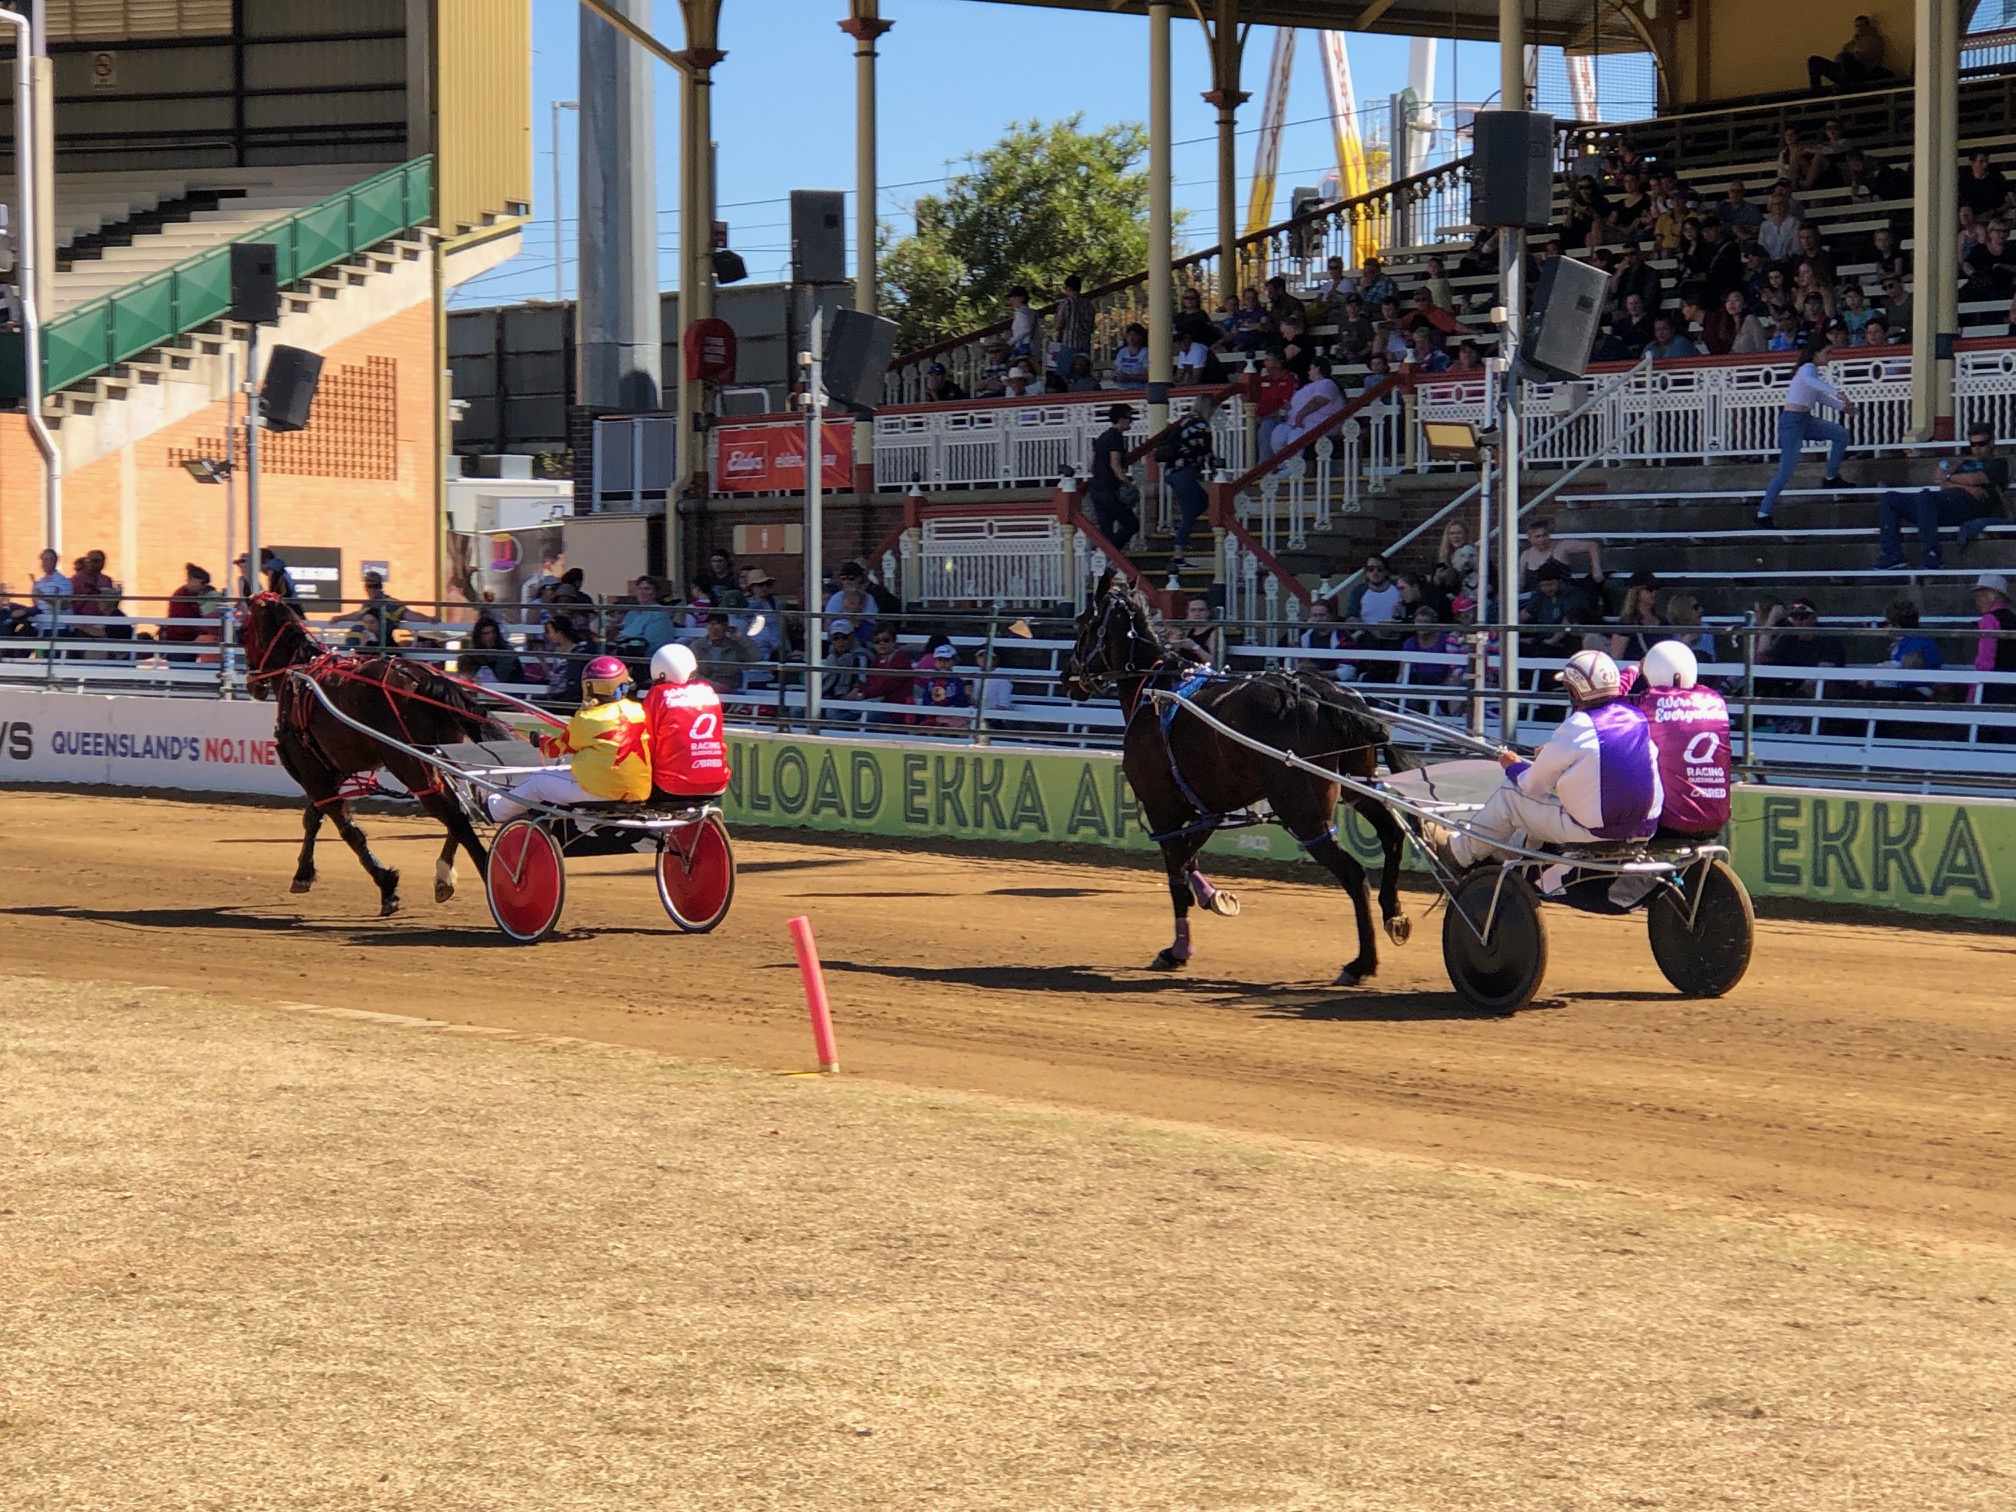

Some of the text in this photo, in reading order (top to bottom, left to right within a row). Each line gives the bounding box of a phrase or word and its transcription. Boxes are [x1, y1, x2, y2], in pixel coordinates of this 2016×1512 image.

[51, 731, 284, 766] QUEENSLAND'S NO.1 NE
[691, 742, 721, 751] RACING
[1686, 767, 1724, 777] RACING
[904, 753, 1049, 833] EKKA
[1764, 797, 1993, 900] EKKA
